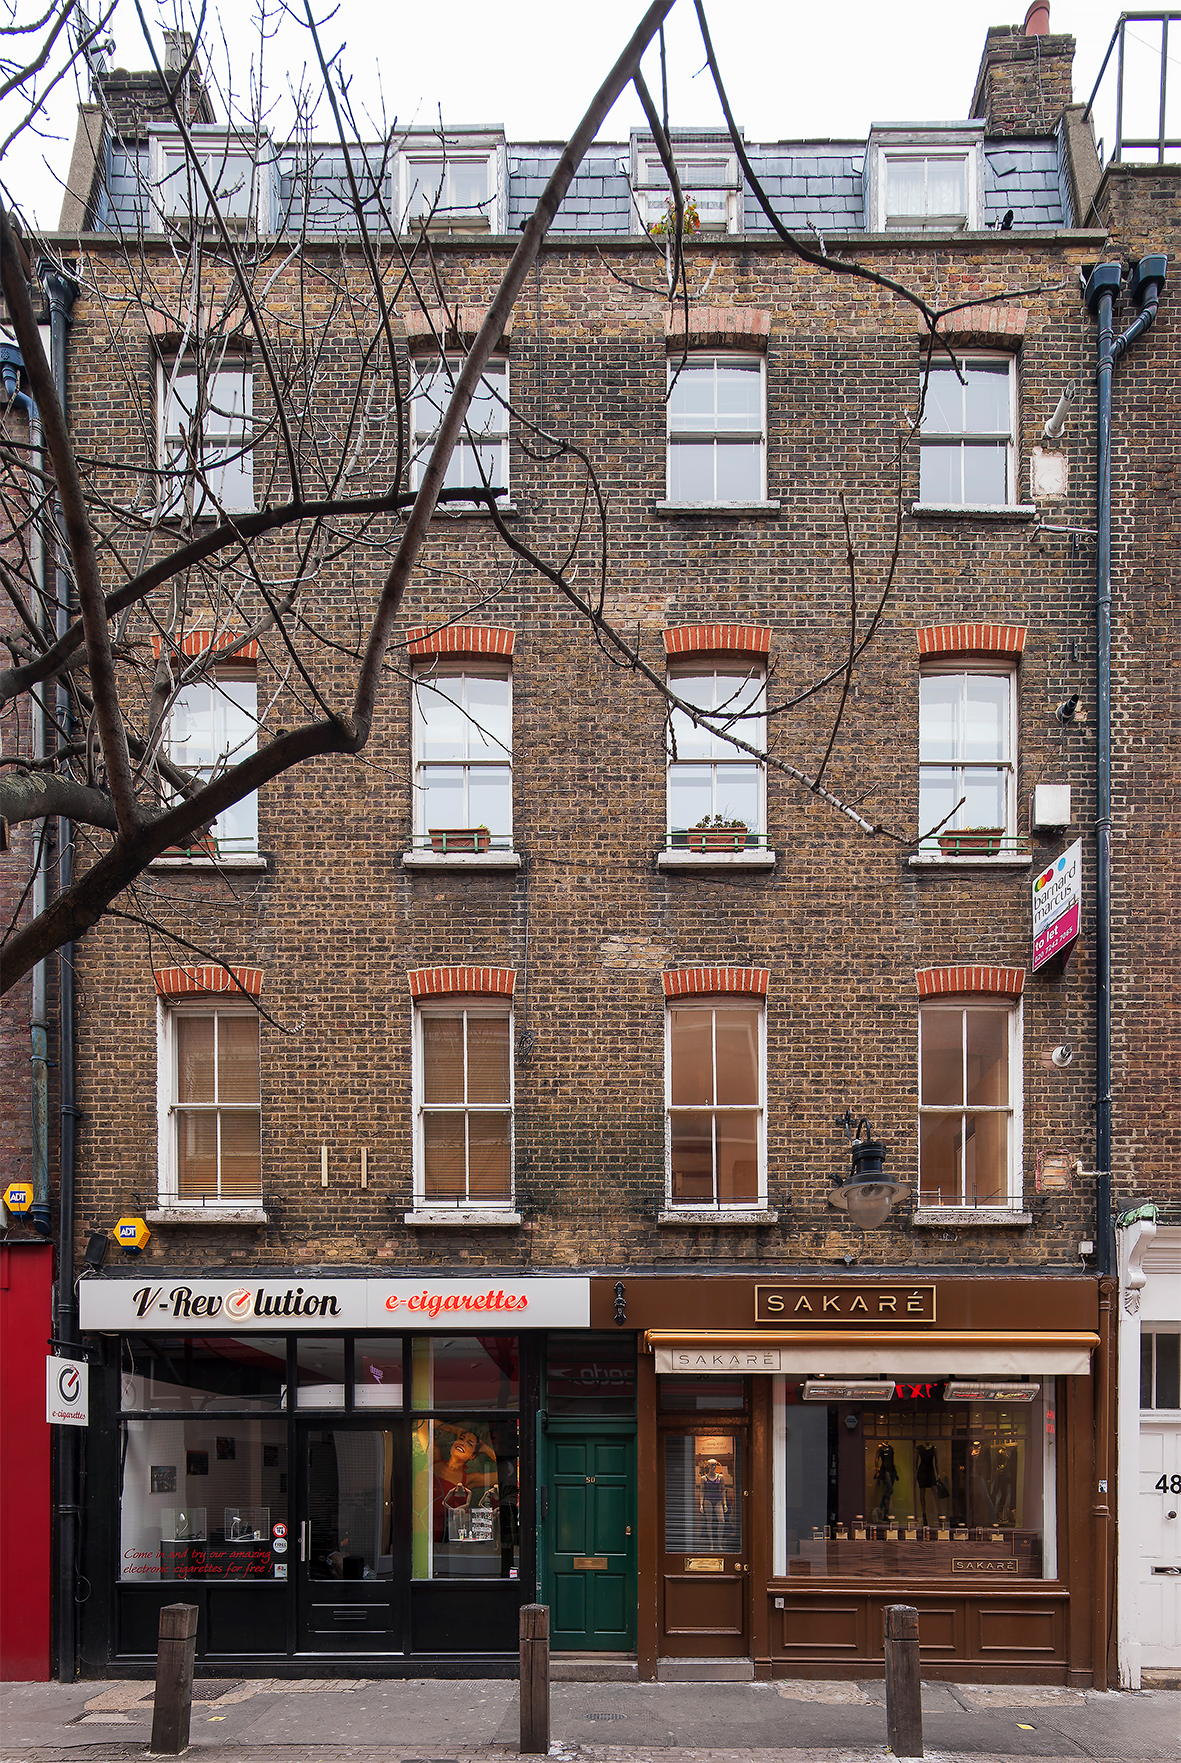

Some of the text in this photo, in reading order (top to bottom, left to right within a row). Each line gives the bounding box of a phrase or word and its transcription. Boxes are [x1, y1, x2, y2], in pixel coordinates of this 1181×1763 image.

[1034, 861, 1076, 910] barnard
[1034, 883, 1072, 924] marcus
[1035, 924, 1059, 952] to let
[10, 1192, 26, 1202] ADT
[120, 1227, 136, 1237] ADT
[132, 1286, 529, 1322] V-Revolution e-cigarettes
[767, 1291, 925, 1312] SAKARÉ
[678, 1352, 774, 1365] SAKARÉ
[52, 1409, 86, 1421] e-cigarettes
[585, 1476, 596, 1484] 50
[1154, 1474, 1181, 1494] 48
[123, 1547, 271, 1563] Come in and try our amazing
[123, 1563, 170, 1574] electronic
[174, 1563, 223, 1579] cigarettes
[223, 1562, 242, 1579] for
[241, 1562, 265, 1579] free
[268, 1562, 274, 1573] !
[956, 1561, 1014, 1570] SAKARÉ
